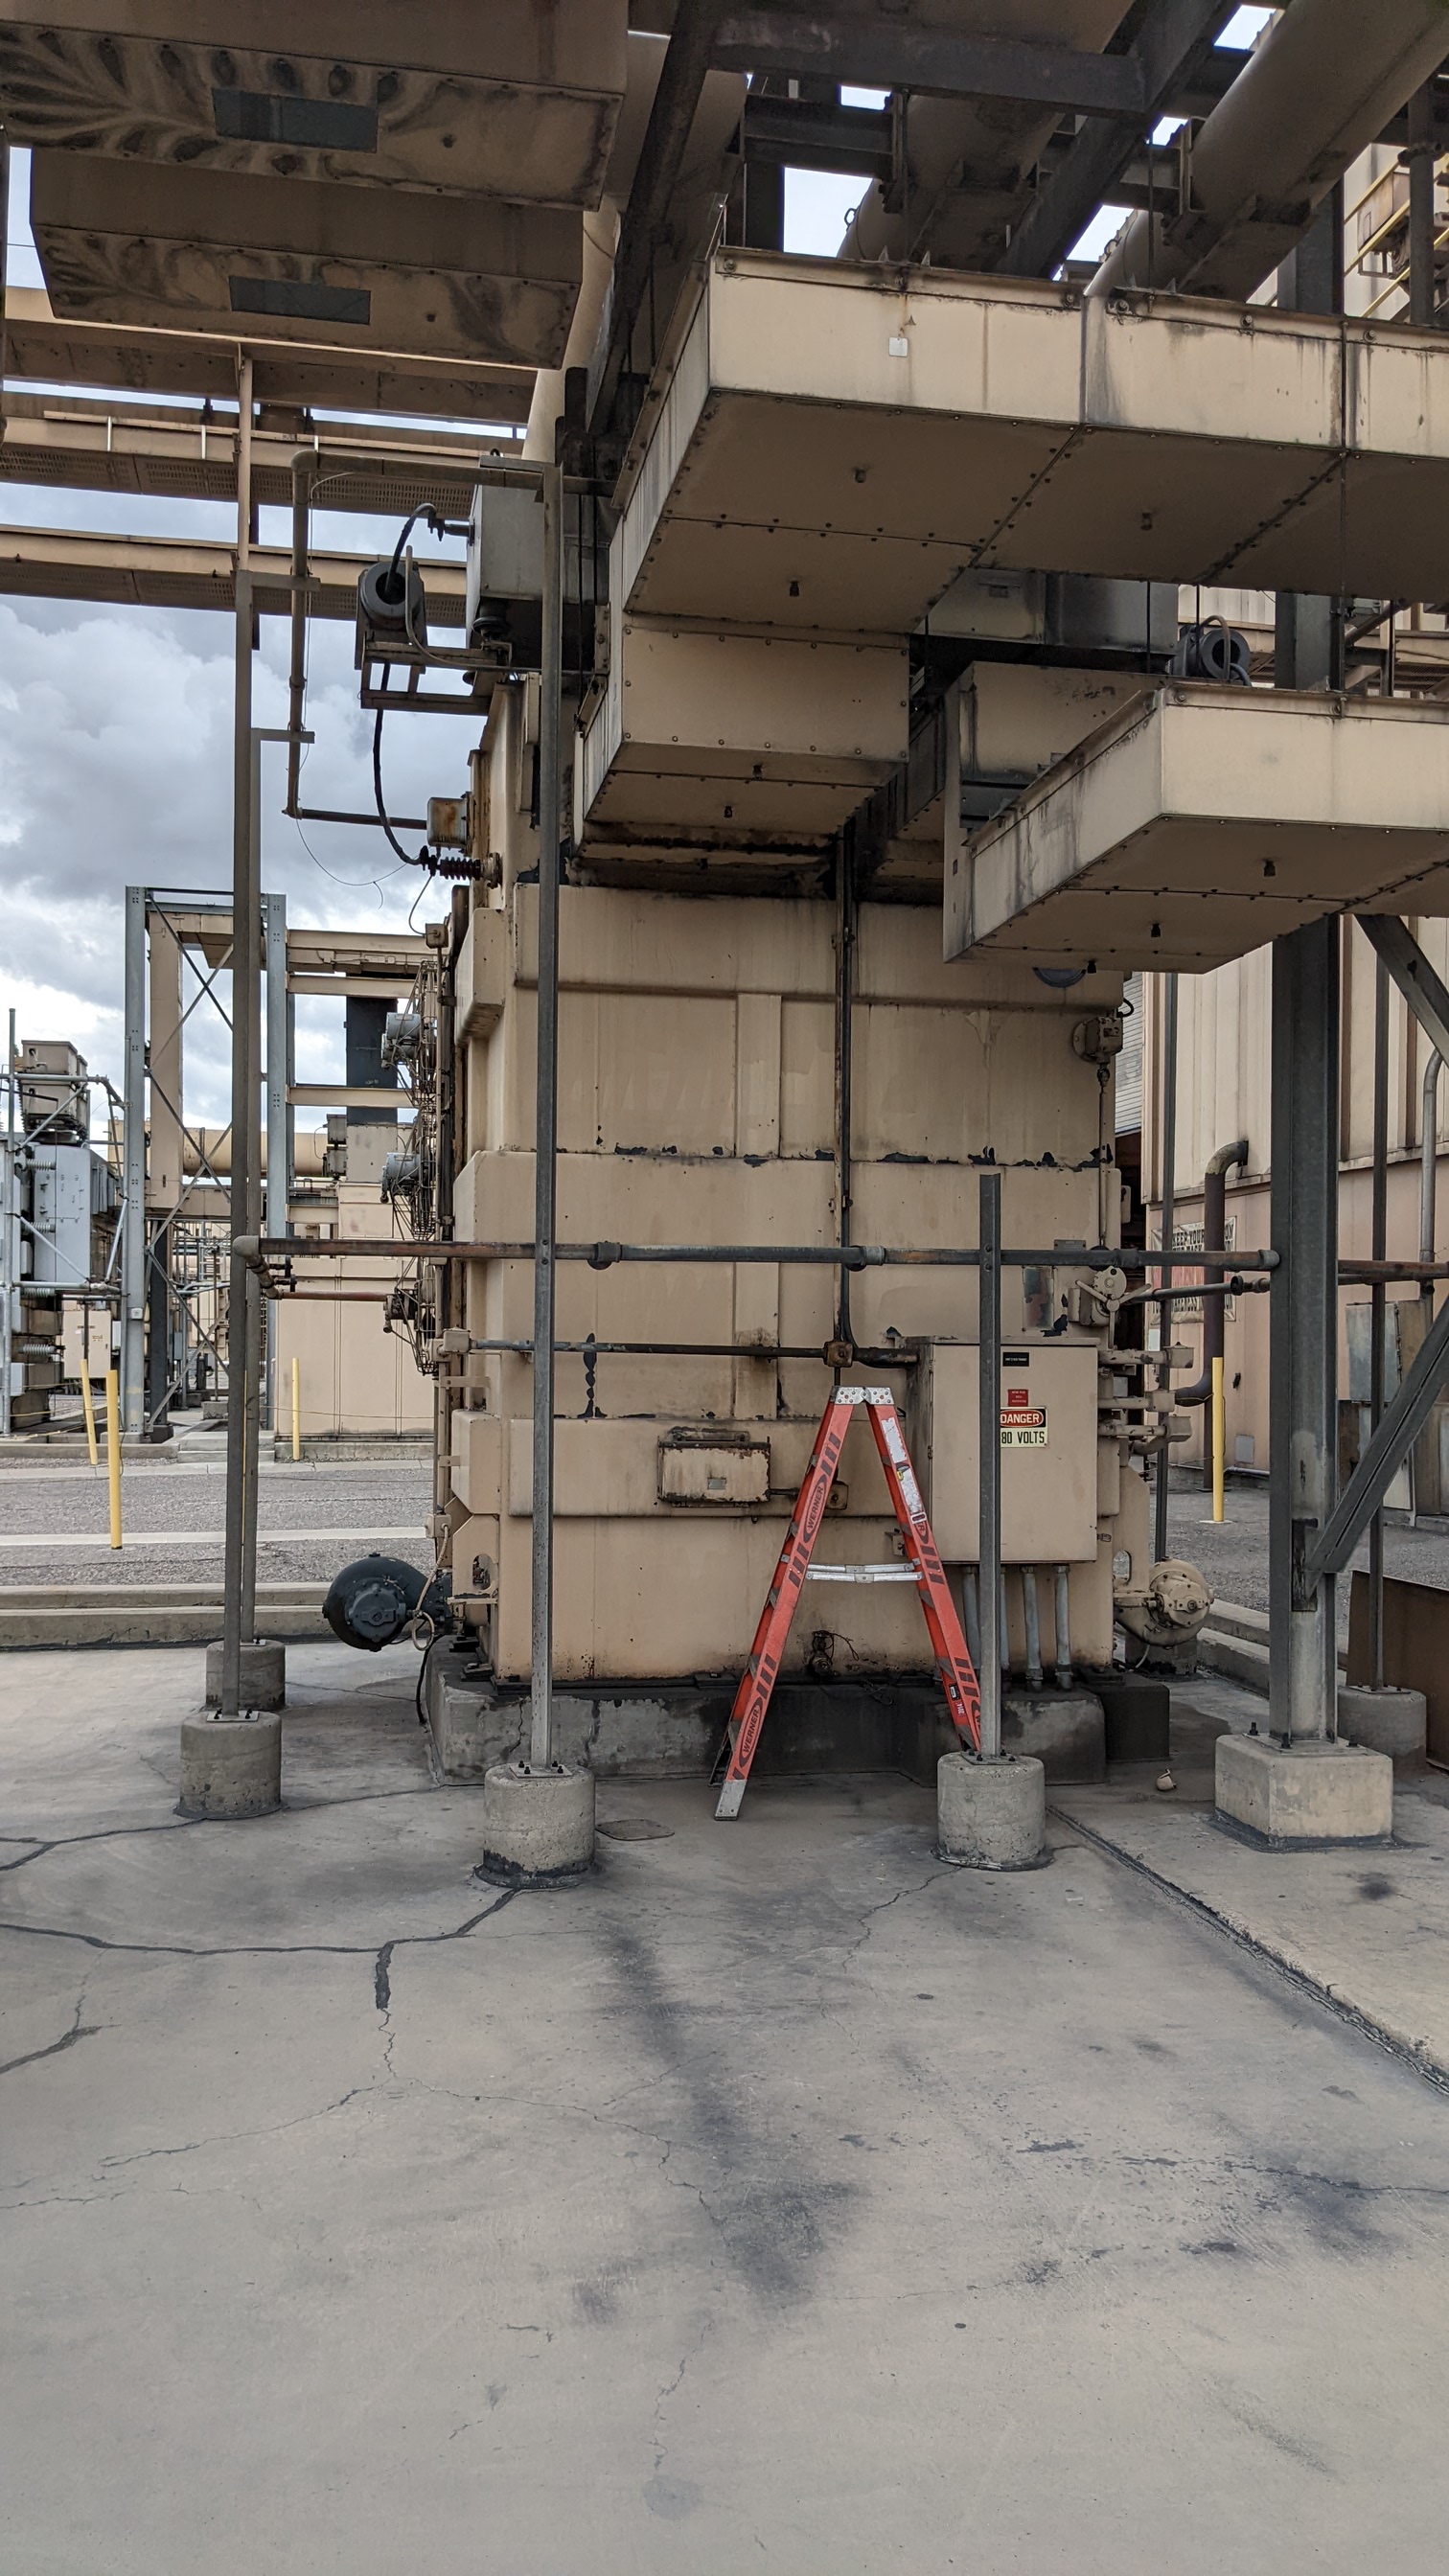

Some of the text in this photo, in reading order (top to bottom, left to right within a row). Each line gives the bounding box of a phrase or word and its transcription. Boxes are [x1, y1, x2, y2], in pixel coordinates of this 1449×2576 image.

[1000, 1414, 1040, 1424] DANGER
[1001, 1431, 1045, 1444] 80 VOLTS
[807, 1486, 823, 1529] WERNER
[743, 1709, 760, 1753] WERNER
